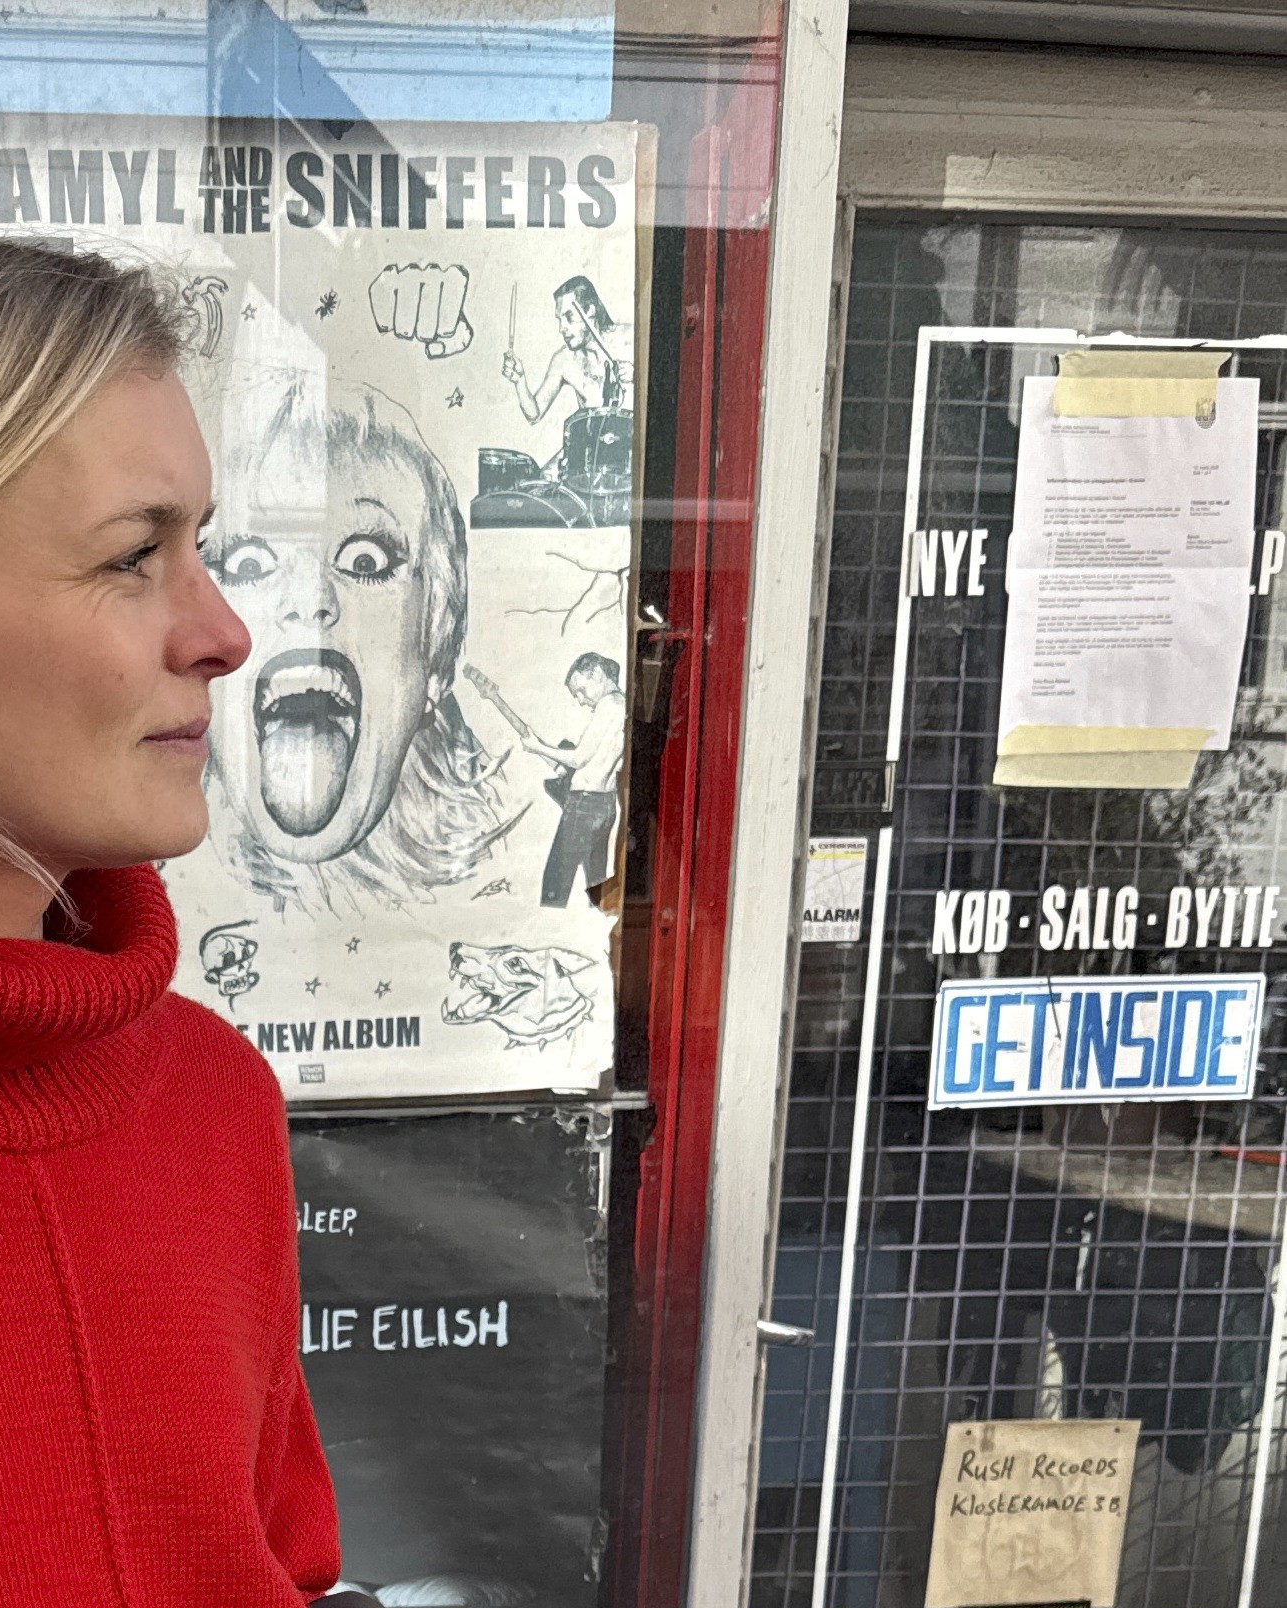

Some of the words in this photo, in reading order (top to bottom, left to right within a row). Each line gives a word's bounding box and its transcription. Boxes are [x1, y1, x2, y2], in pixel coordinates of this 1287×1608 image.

[198, 146, 271, 187] AND
[286, 149, 617, 229] SNIFFERS
[198, 187, 271, 234] THE
[908, 528, 989, 597] NYE
[803, 908, 860, 923] ALARM
[932, 889, 1011, 955] KØB
[1039, 885, 1139, 951] SALG
[1164, 884, 1281, 949] BYTTE
[258, 1021, 317, 1053] NEW
[323, 1016, 421, 1051] ALBUM
[943, 991, 1062, 1095] GET
[1061, 988, 1248, 1090] INSIDE
[298, 1304, 359, 1355] LIE
[372, 1300, 510, 1352] EILISH
